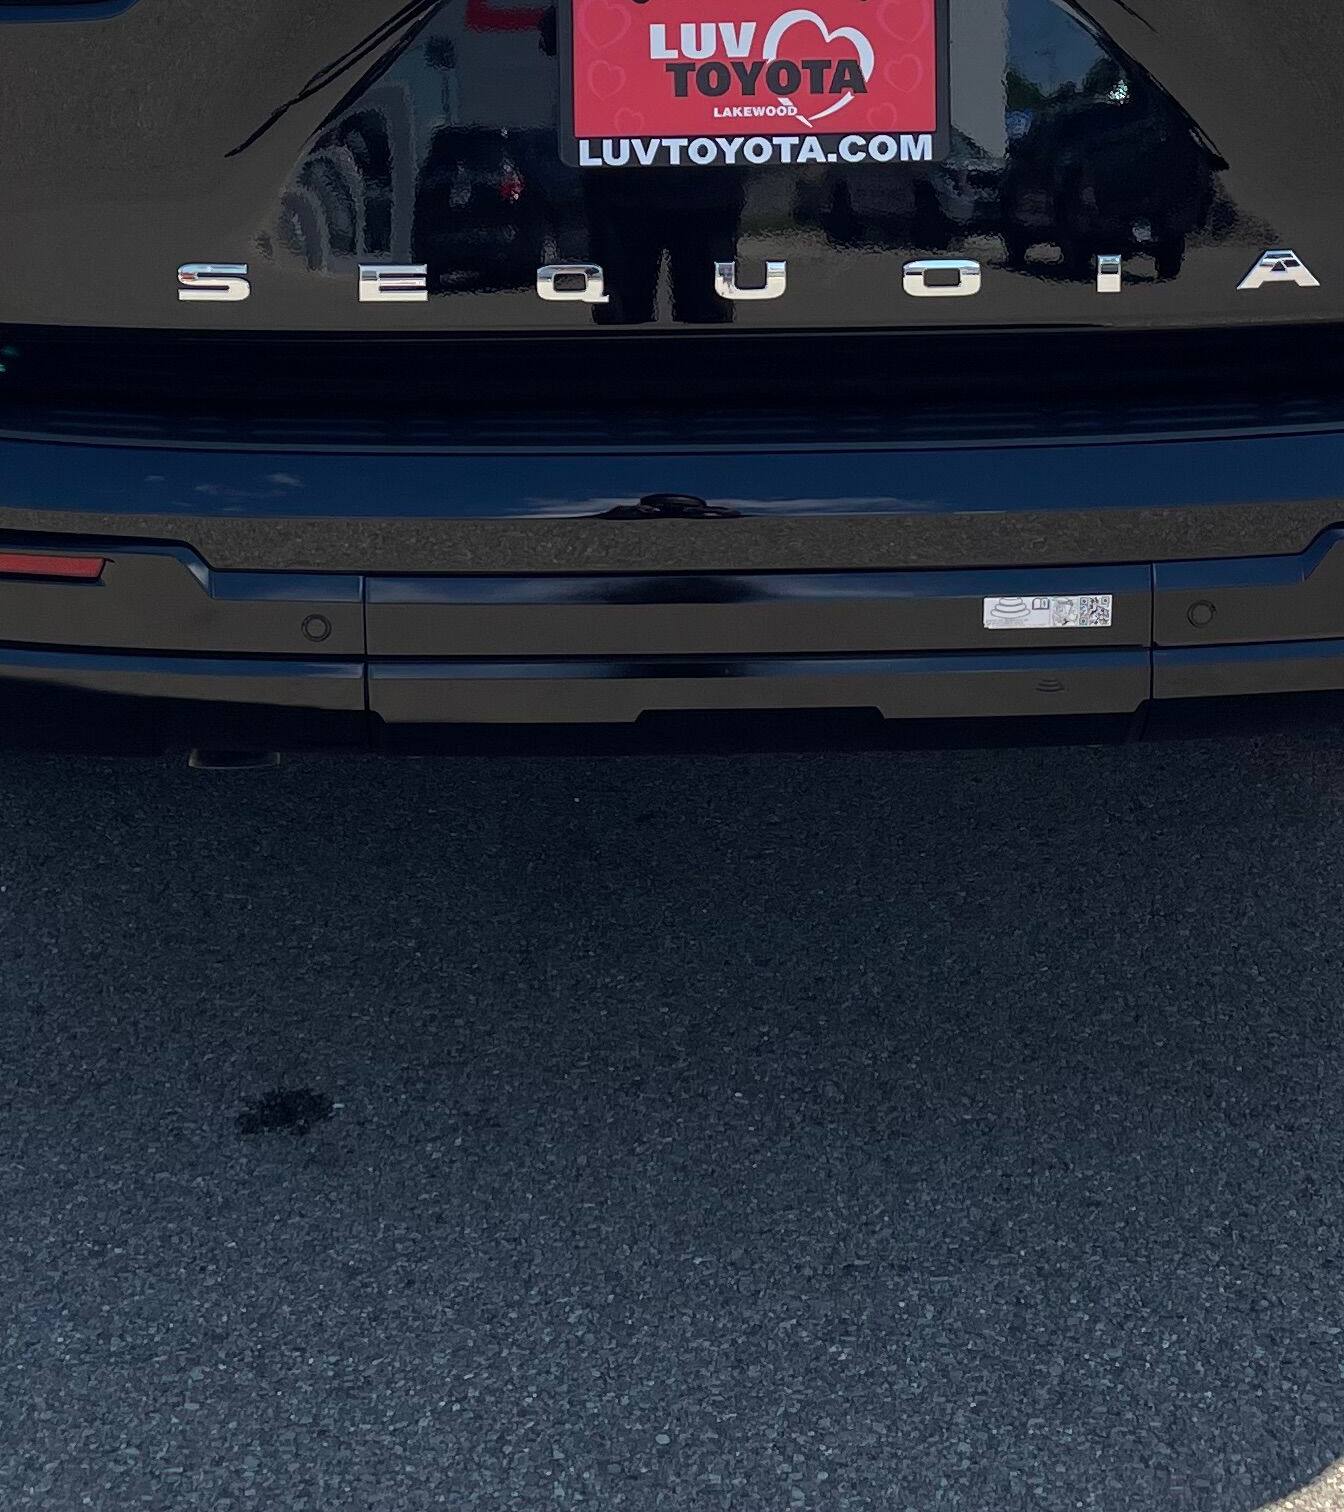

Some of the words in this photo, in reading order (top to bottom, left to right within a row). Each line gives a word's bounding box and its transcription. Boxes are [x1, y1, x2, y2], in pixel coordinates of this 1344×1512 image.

[649, 21, 757, 60] LUV
[665, 59, 868, 98] TOYOTA
[713, 105, 798, 118] LAKEWOOD
[578, 133, 934, 167] LUVTOYOTA.COM
[176, 249, 1321, 303] SEQUOIA
